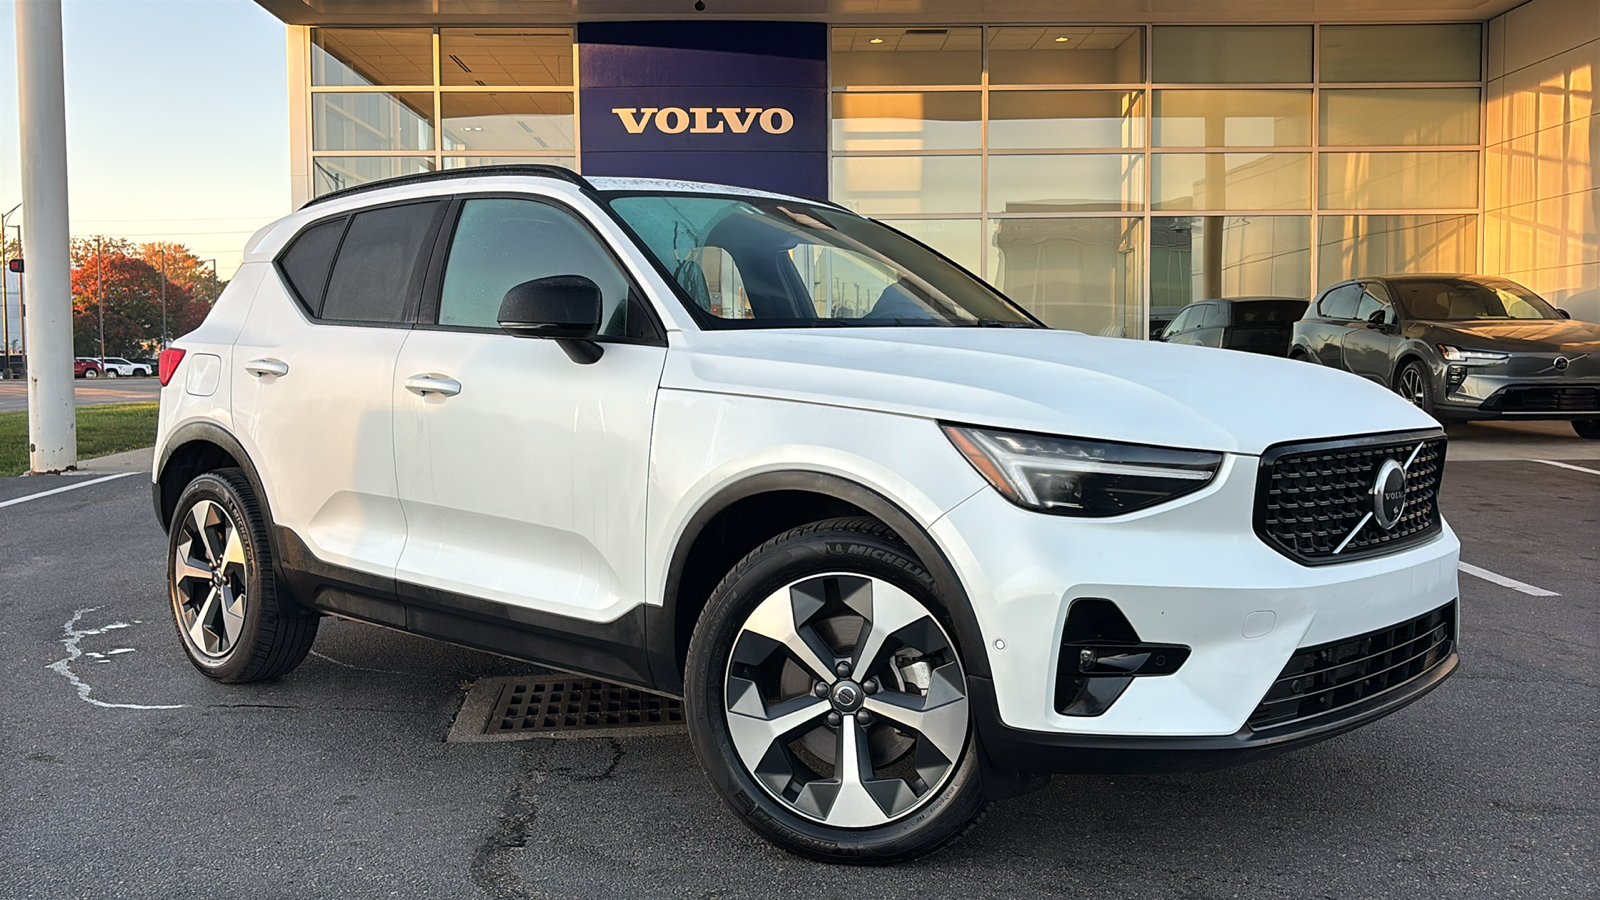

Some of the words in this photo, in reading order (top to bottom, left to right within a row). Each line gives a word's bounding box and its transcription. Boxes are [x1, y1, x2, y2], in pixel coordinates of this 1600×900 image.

[611, 107, 794, 134] VOLVO
[232, 509, 252, 560] MICHELIN
[847, 544, 932, 585] MICHELIN
